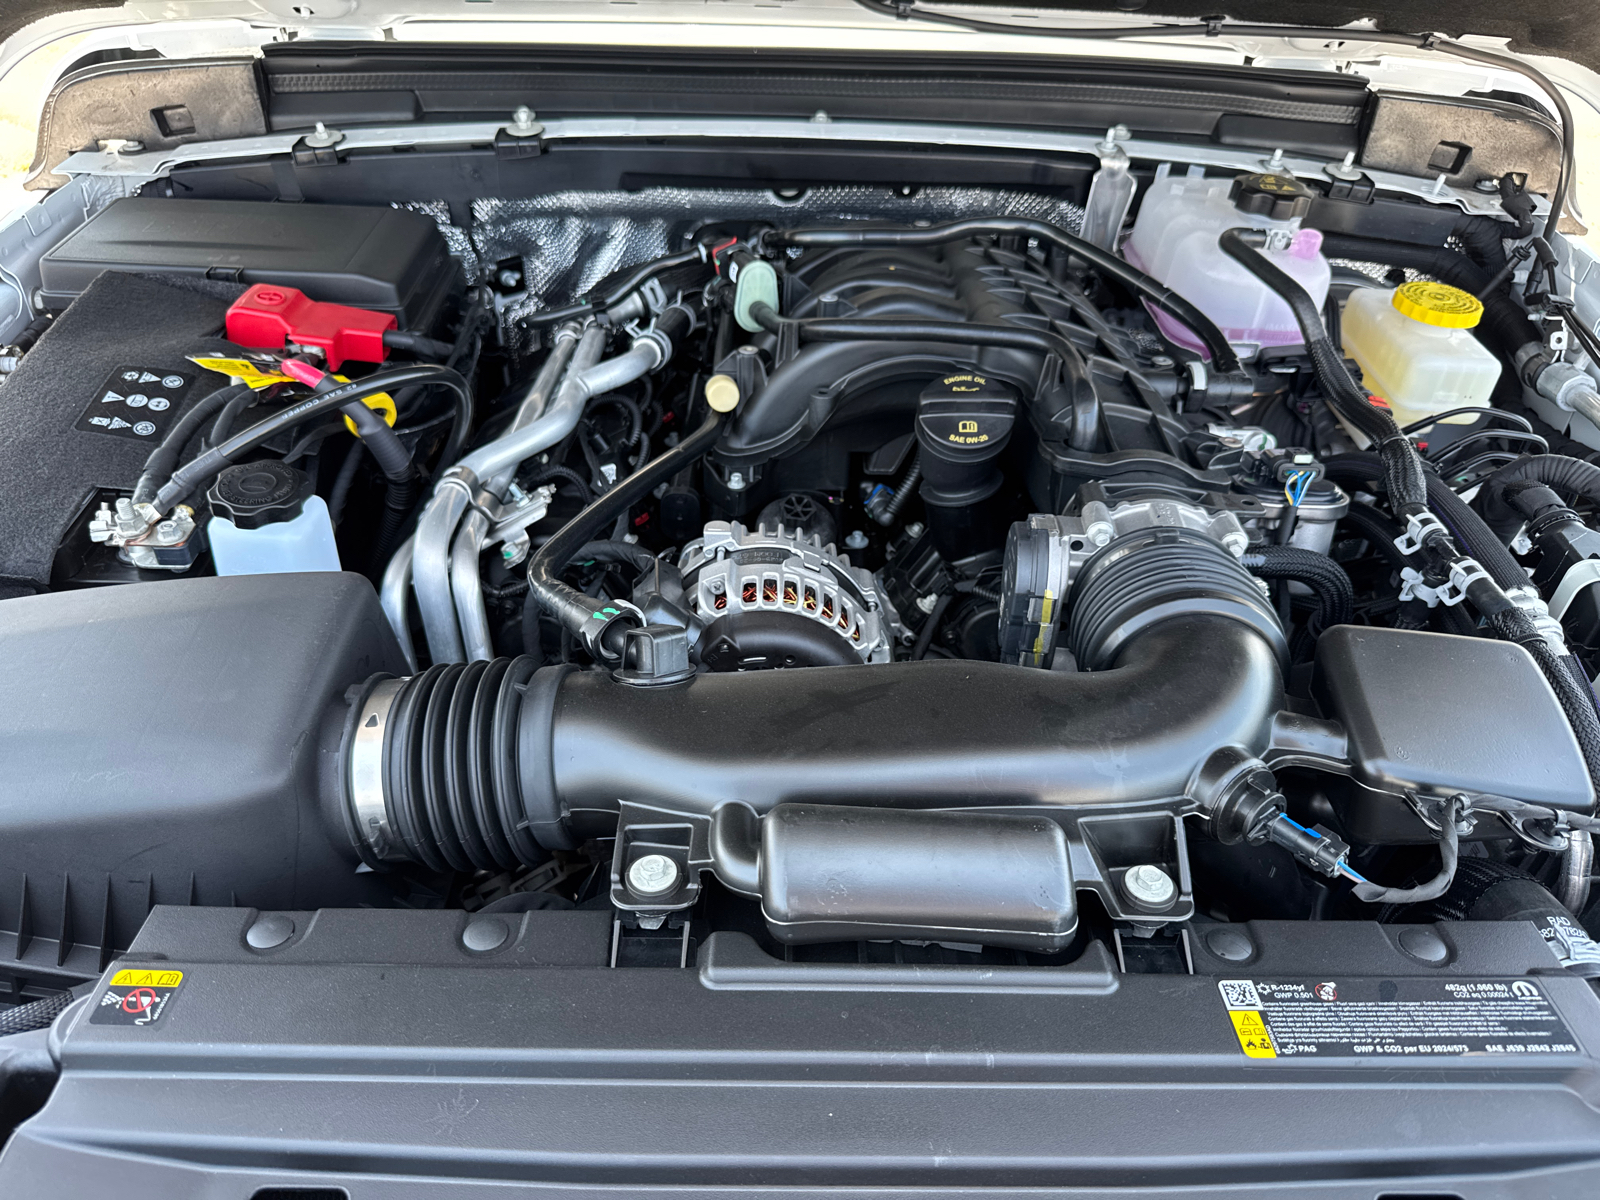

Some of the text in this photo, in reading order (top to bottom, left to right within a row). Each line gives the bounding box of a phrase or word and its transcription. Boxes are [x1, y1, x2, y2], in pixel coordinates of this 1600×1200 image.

[943, 375, 987, 385] ENGINE OIL
[323, 389, 343, 400] SAE
[281, 398, 320, 420] COPPER
[949, 434, 989, 444] SAE 0W-20
[1546, 916, 1571, 926] RAD
[1353, 1045, 1374, 1053] GWP
[1375, 1045, 1383, 1053] &
[1384, 1045, 1403, 1053] CO2
[1404, 1046, 1417, 1054] per
[1485, 1044, 1505, 1052] SAE
